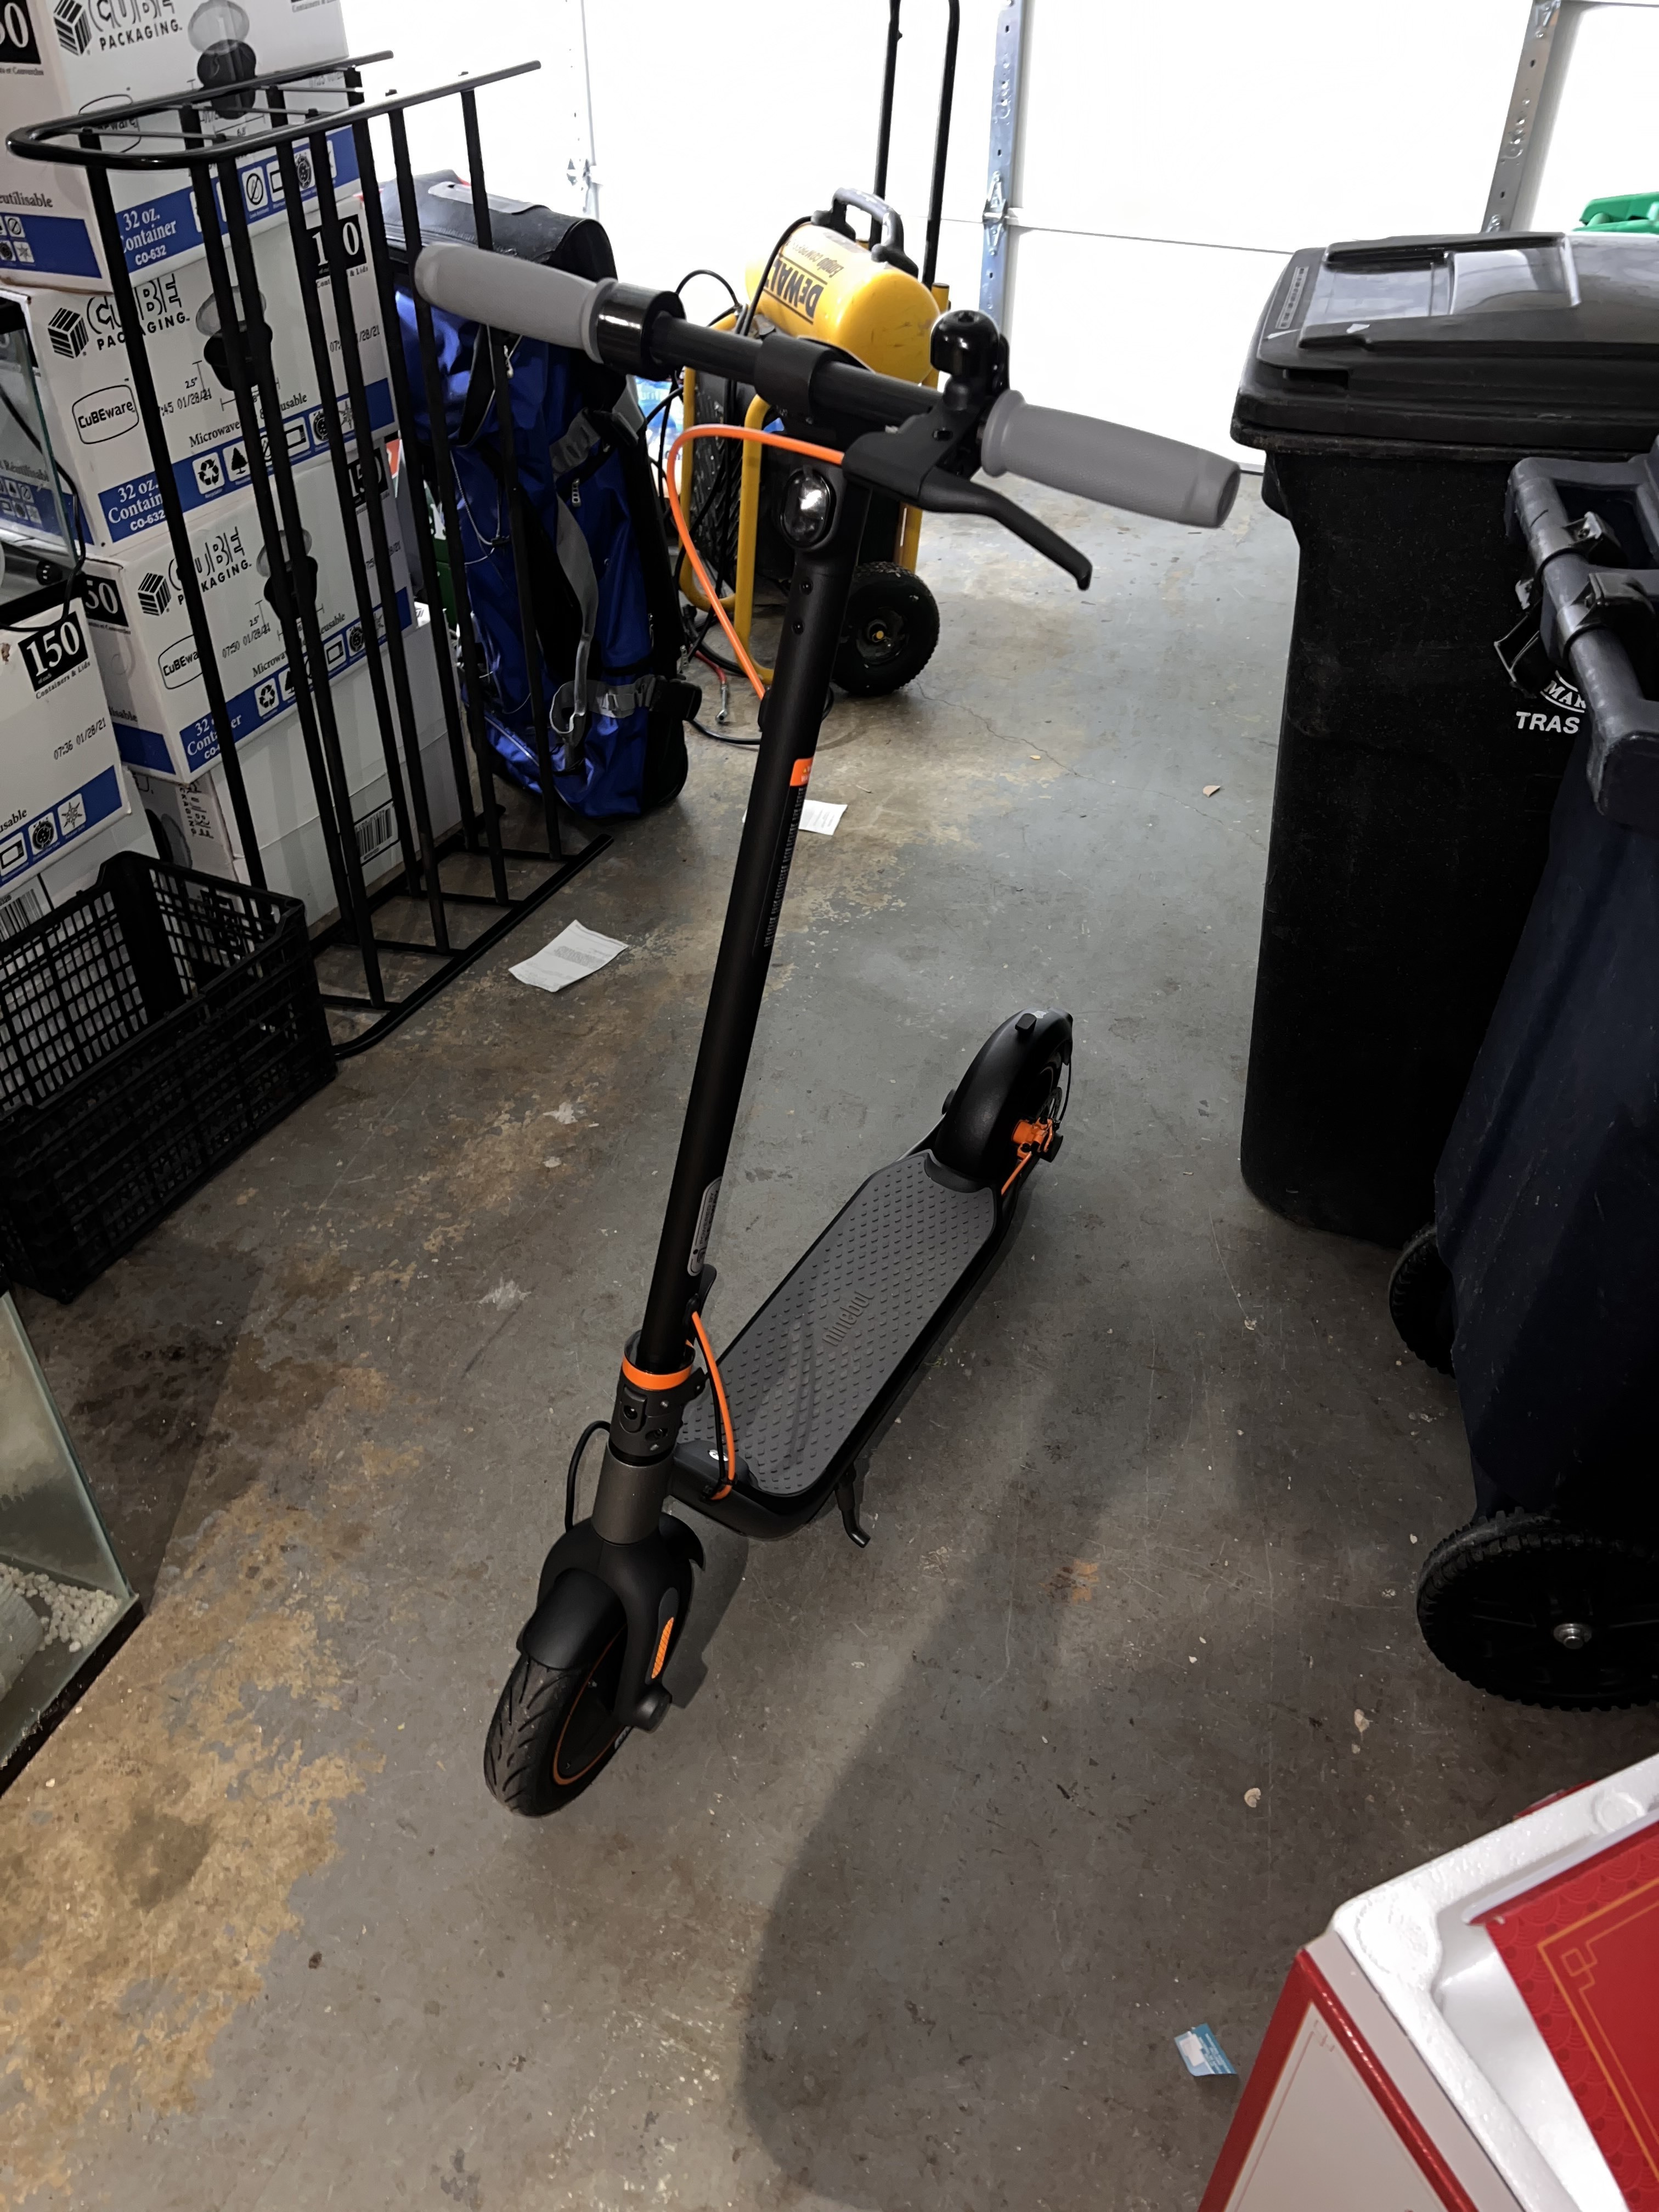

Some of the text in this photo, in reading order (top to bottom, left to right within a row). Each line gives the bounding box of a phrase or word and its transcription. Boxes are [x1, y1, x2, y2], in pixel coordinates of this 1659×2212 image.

[123, 208, 160, 231] 32 oz.
[189, 421, 241, 448] Microwave
[280, 392, 307, 411] usable
[117, 479, 159, 503] 32 oz.
[108, 493, 163, 524] Contain
[85, 579, 119, 614] 50
[26, 621, 80, 677] 150
[163, 651, 198, 676] CuBEwa
[252, 651, 286, 678] Microwa
[76, 716, 106, 746] 01/28/21
[194, 718, 210, 736] 32
[1516, 710, 1581, 734] TRAS
